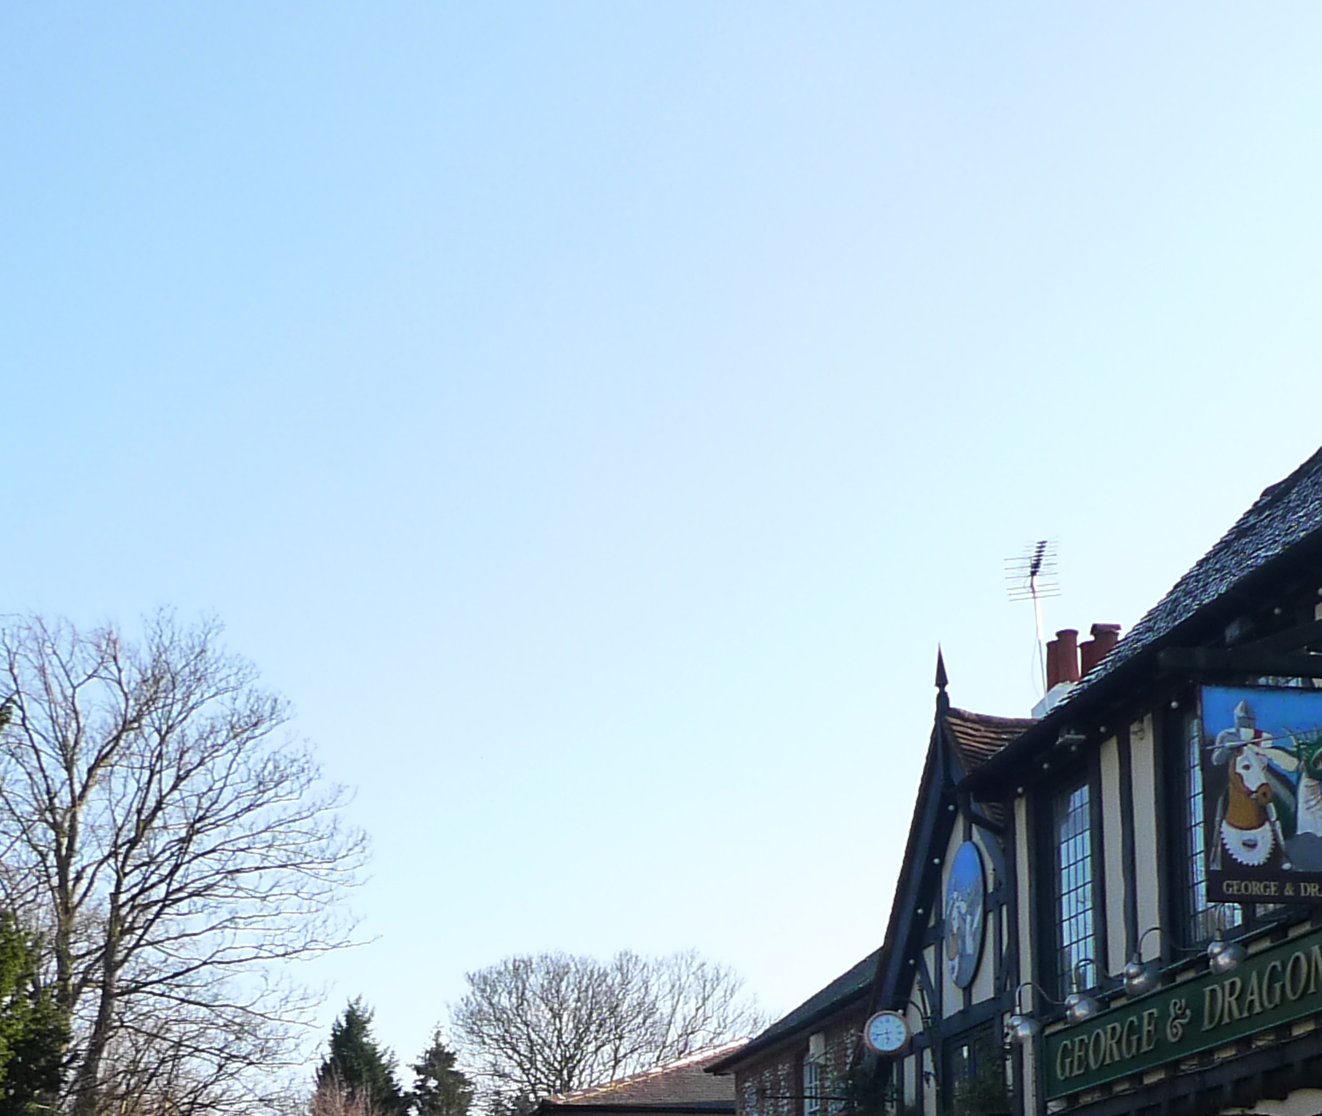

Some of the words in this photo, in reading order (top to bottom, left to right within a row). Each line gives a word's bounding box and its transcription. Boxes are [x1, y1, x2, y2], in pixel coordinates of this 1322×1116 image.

[1222, 880, 1279, 896] GEORGE
[1283, 881, 1295, 896] &
[1056, 1007, 1159, 1081] GEORGE
[1166, 998, 1191, 1043] &
